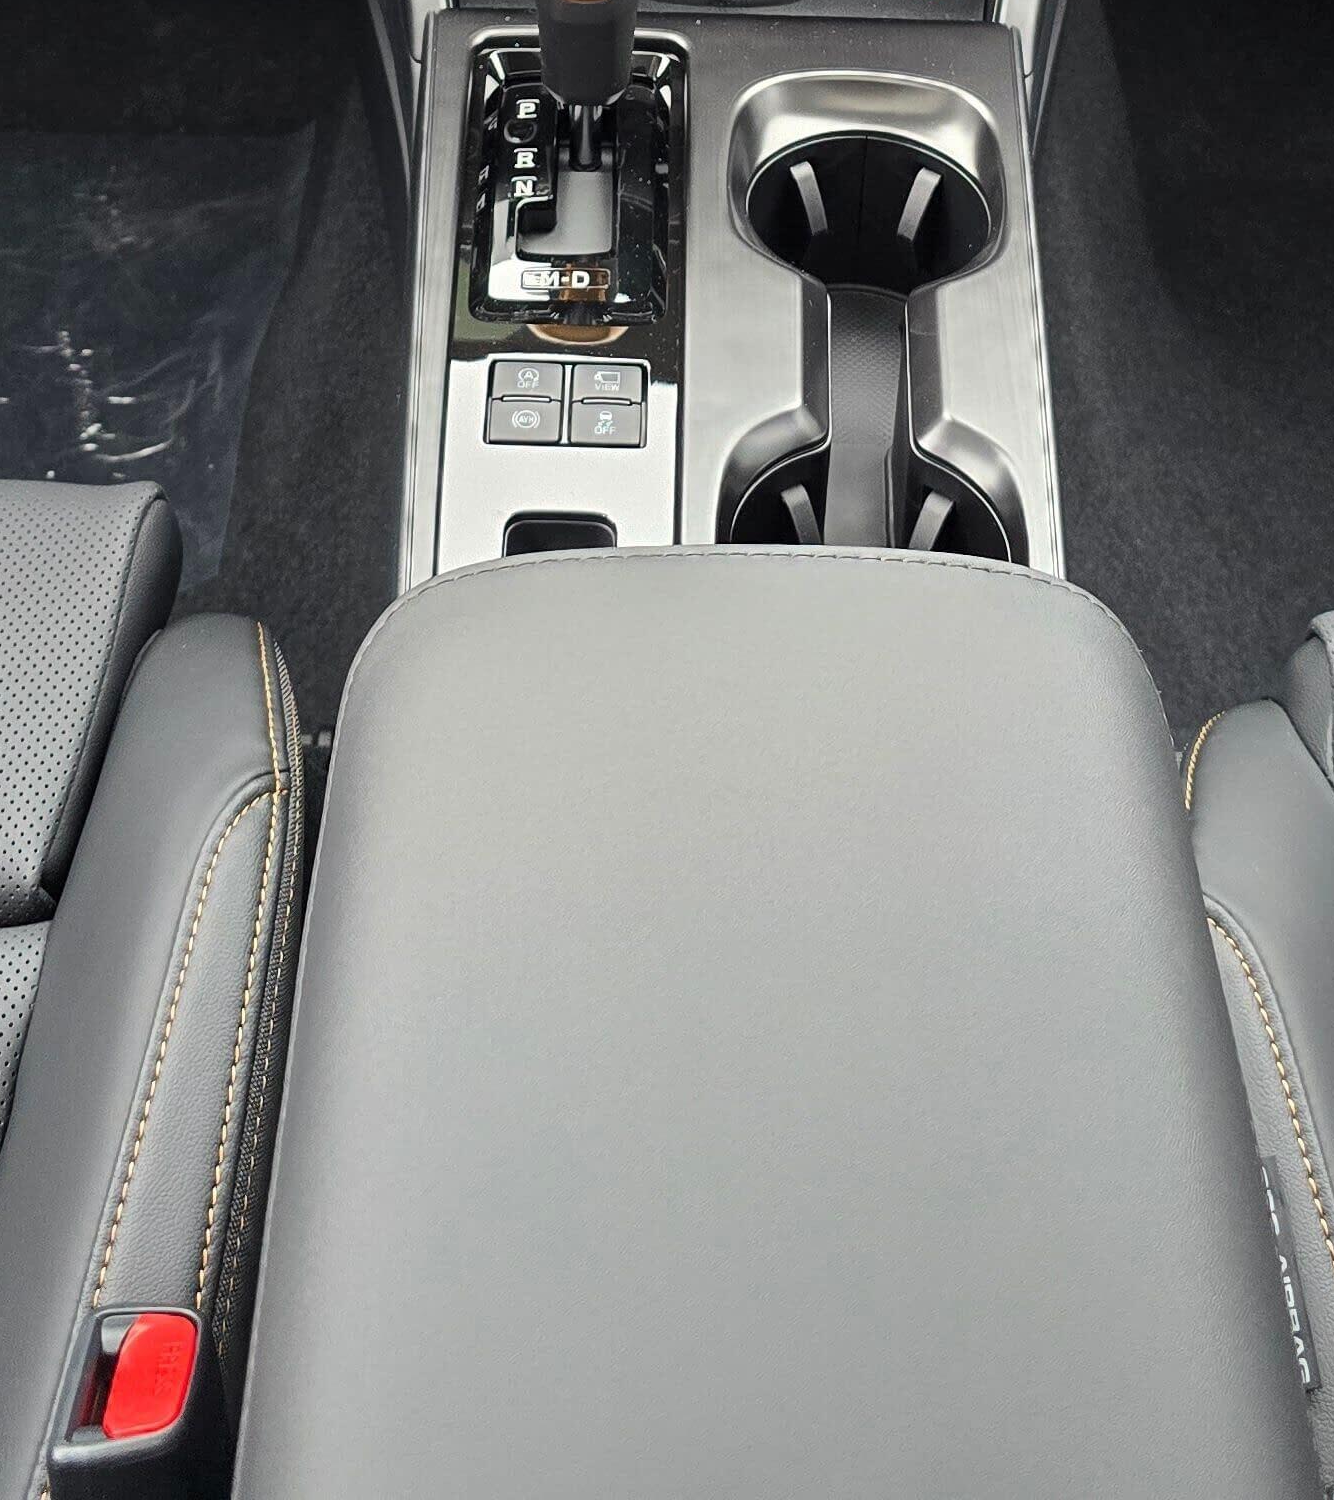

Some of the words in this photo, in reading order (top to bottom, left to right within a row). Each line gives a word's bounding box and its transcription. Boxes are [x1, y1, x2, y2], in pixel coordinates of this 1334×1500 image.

[516, 100, 540, 120] P
[514, 150, 538, 168] R
[511, 178, 536, 197] N
[595, 382, 620, 391] VIEW
[594, 425, 616, 435] OFF
